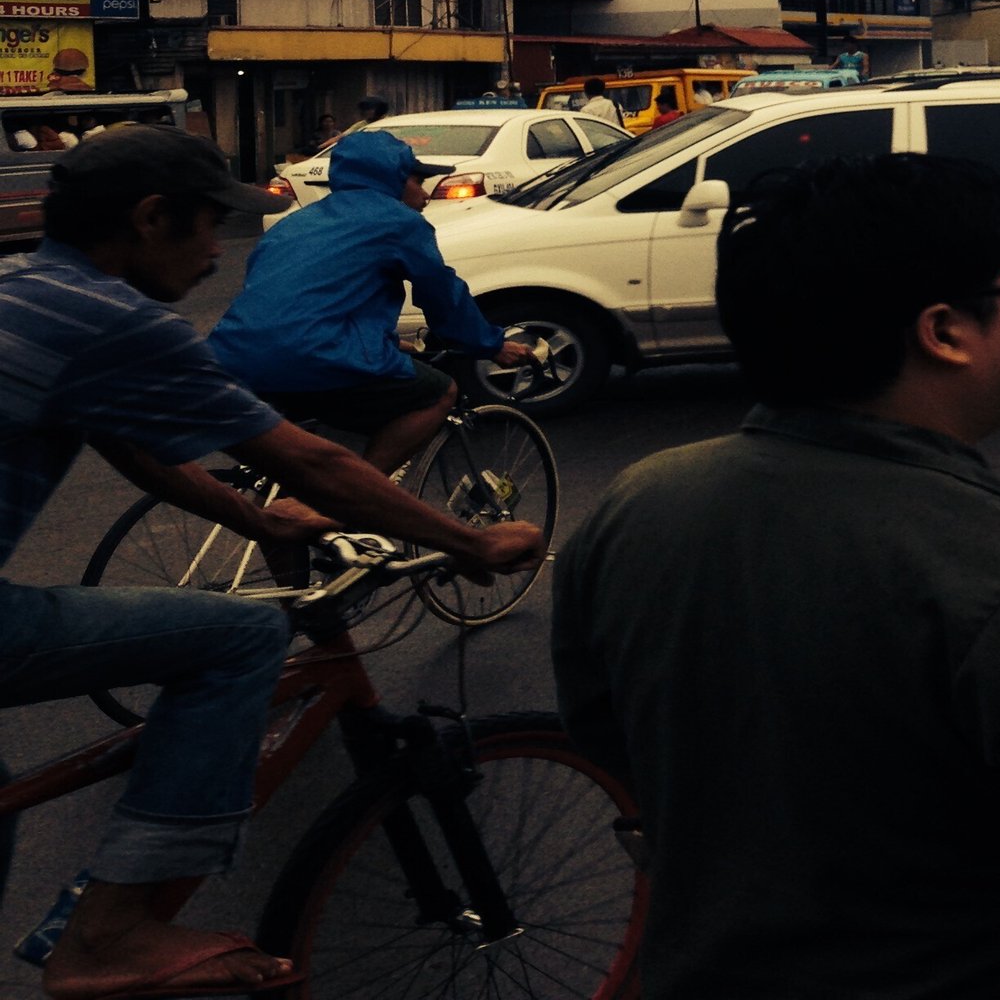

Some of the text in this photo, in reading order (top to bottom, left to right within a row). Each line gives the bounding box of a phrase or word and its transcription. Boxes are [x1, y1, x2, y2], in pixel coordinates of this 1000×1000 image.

[12, 5, 80, 16] HOURS
[103, 0, 136, 10] pepsi
[7, 71, 11, 82] 1
[14, 70, 37, 82] TAKE
[39, 70, 44, 82] 1
